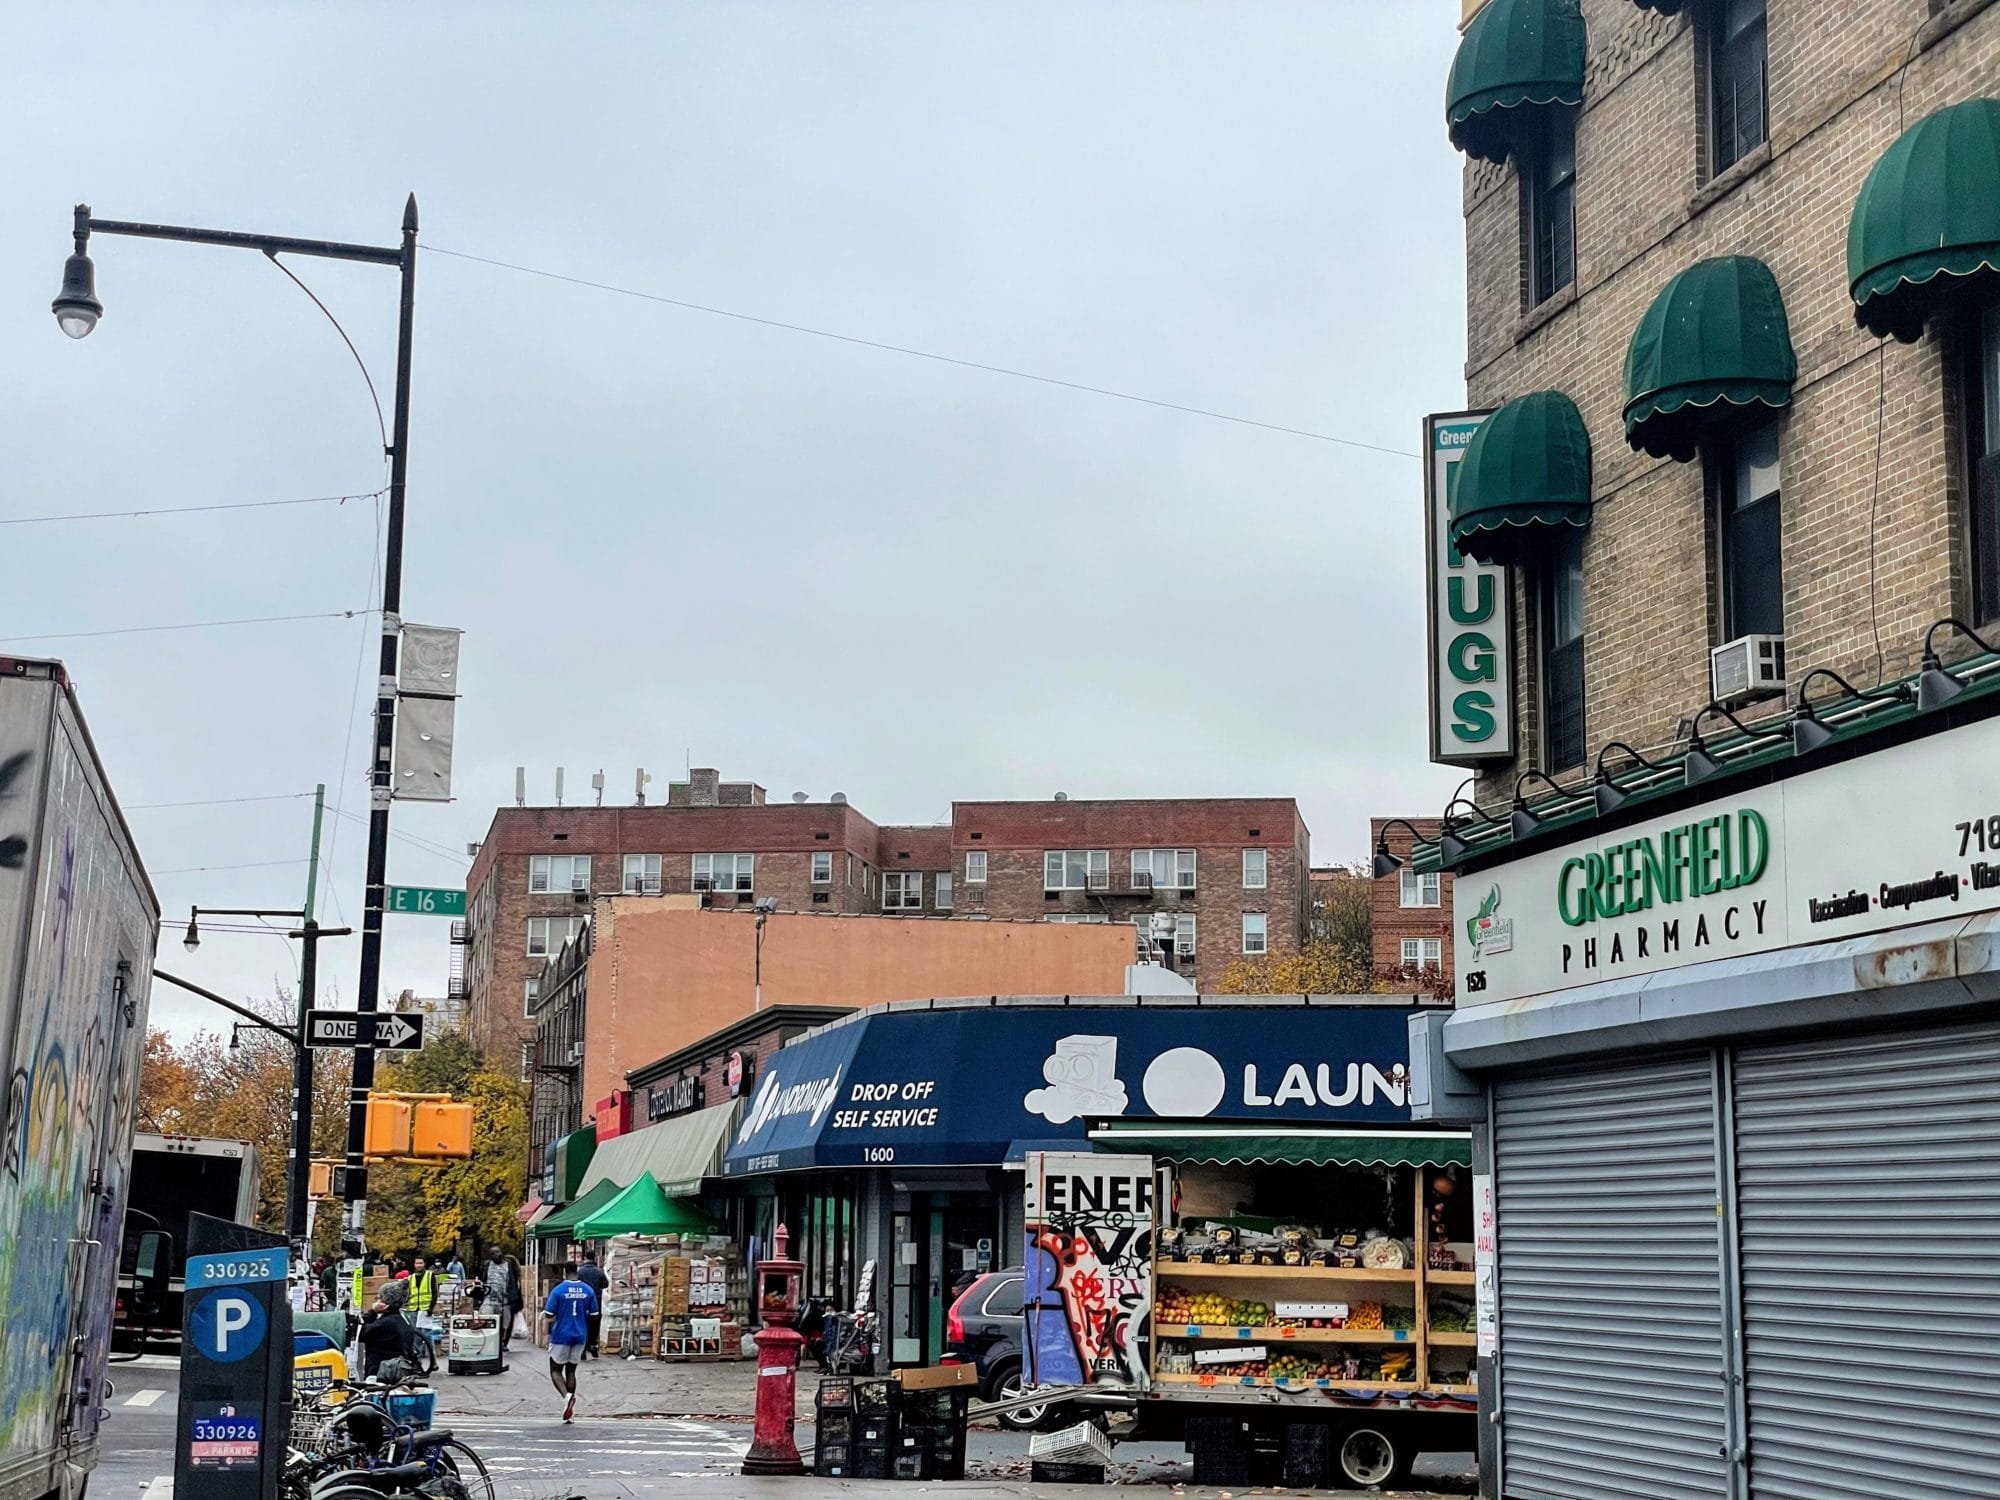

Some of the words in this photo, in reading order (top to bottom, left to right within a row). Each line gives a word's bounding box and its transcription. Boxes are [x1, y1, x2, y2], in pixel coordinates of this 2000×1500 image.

[1447, 461, 1497, 743] UGS
[1955, 815, 2000, 857] 718
[1558, 808, 1769, 926] GREENFIELD
[395, 889, 408, 910] E
[417, 890, 436, 912] 16
[443, 892, 460, 904] ST
[1563, 900, 1767, 973] PHARMACY
[323, 1022, 358, 1037] ONE
[851, 1083, 898, 1101] DROP
[901, 1081, 935, 1100] OFF
[1244, 1062, 1412, 1107] LAUN
[832, 1110, 870, 1128] SELF
[871, 1108, 939, 1128] SERVICE
[864, 1147, 895, 1162] 1600
[205, 1263, 270, 1279] 330926
[216, 1298, 251, 1353] P
[195, 1425, 257, 1440] 330926
